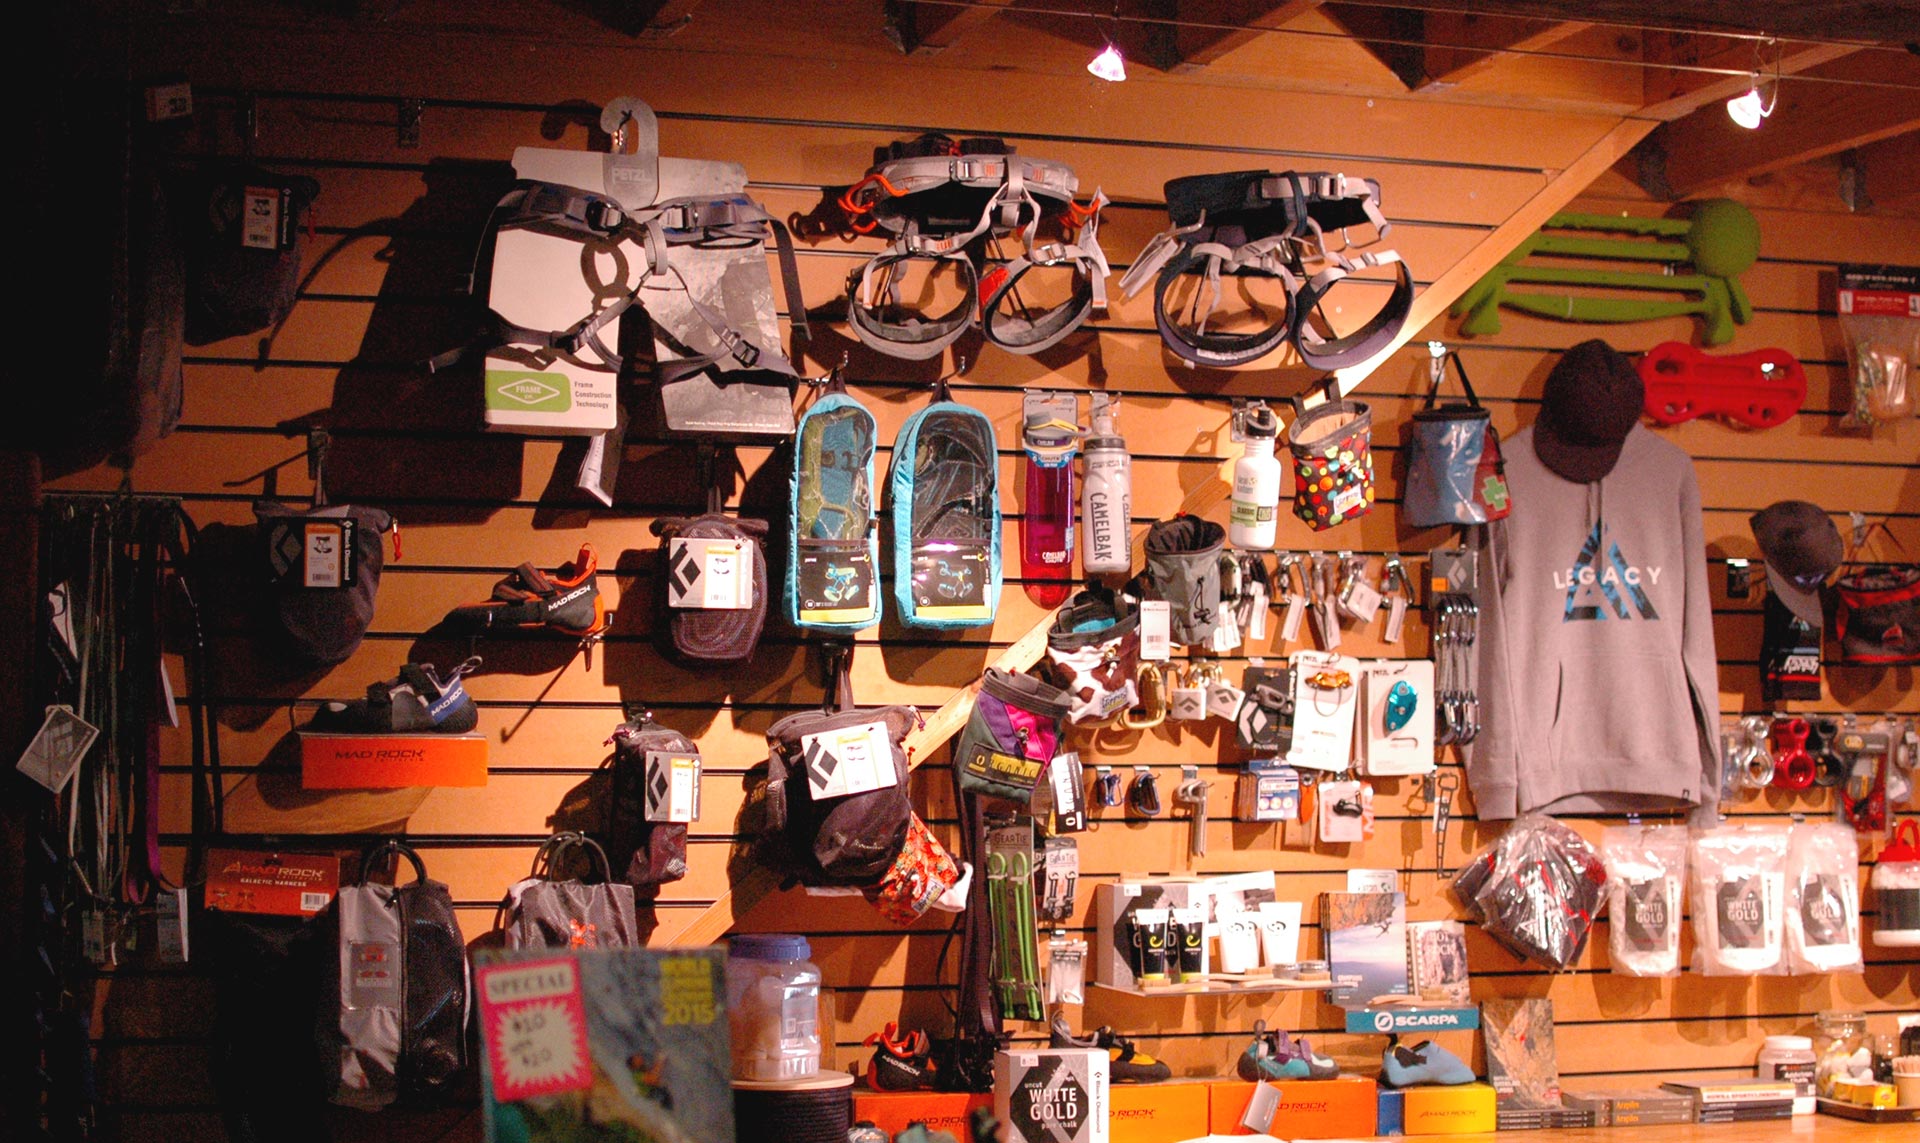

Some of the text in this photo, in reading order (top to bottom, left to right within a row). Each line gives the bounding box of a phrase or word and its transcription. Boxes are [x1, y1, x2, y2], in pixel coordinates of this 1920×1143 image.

[611, 167, 653, 184] PETZL
[515, 385, 542, 394] FRAME
[575, 390, 612, 399] Construction
[575, 400, 609, 409] Technology
[1090, 492, 1112, 561] CAMELBAK
[1553, 566, 1661, 590] LEGACY
[548, 584, 591, 612] MAD ROCK
[449, 687, 463, 703] ROC
[335, 749, 423, 759] MAD ROCK
[242, 865, 324, 878] MAD ROCK
[1727, 900, 1756, 911] WHITE
[1635, 912, 1664, 924] GOLD
[1727, 909, 1759, 921] GOLD
[488, 970, 571, 996] SPECIAL
[662, 1000, 716, 1026] 2015
[1395, 1015, 1459, 1027] SCARPA
[1024, 1081, 1043, 1089] uncut
[1029, 1087, 1078, 1103] WHITE
[1030, 1102, 1078, 1121] GOLD
[1294, 1101, 1328, 1110] ROCK
[1117, 1109, 1154, 1118] ROCK
[940, 1116, 966, 1124] ROC
